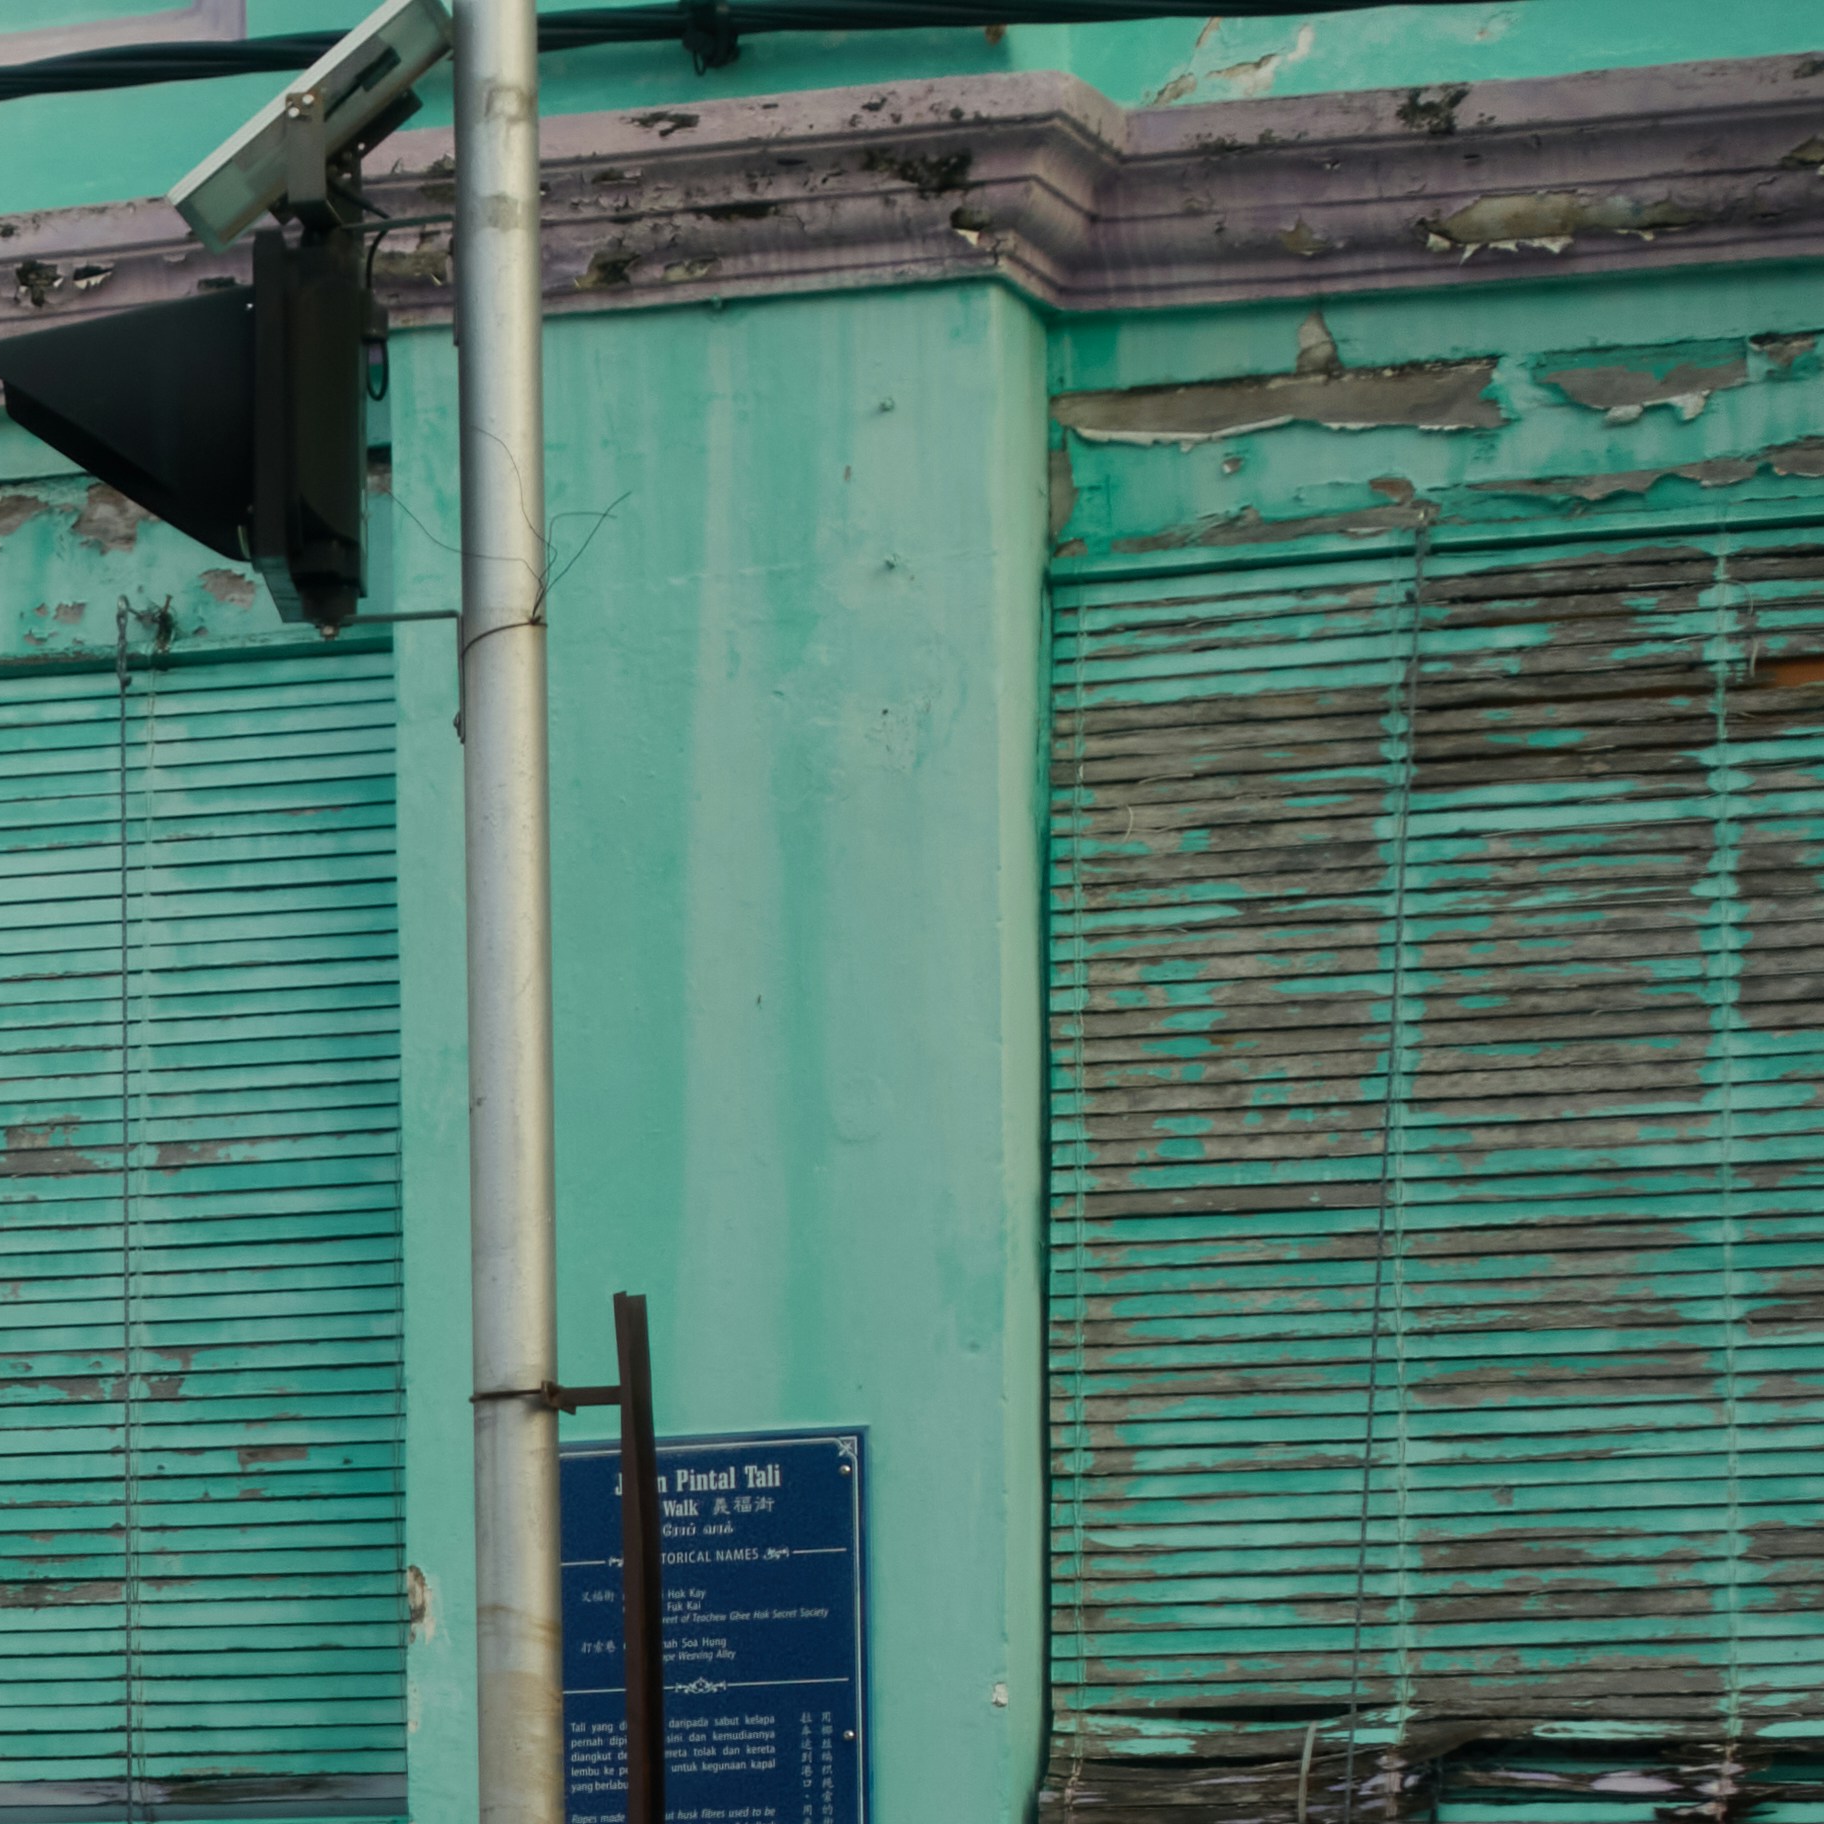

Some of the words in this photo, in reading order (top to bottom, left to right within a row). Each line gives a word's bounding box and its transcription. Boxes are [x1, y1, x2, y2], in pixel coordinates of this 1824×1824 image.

[676, 1466, 736, 1492] Pintal
[744, 1464, 781, 1489] Tali
[663, 1500, 699, 1518] Walk
[661, 1550, 711, 1565] TORICAL
[716, 1548, 759, 1561] NAMES
[667, 1601, 683, 1611] Fuk
[571, 1722, 586, 1732] Tali
[592, 1723, 613, 1733] yang
[669, 1717, 709, 1729] daripada
[715, 1716, 739, 1726] sabut
[745, 1715, 775, 1726] kelapa
[571, 1737, 603, 1748] pernah
[688, 1732, 707, 1742] dan
[713, 1730, 775, 1742] kemudiannya
[571, 1751, 612, 1764] diangkut
[693, 1747, 717, 1757] tolak
[723, 1746, 740, 1756] dan
[746, 1745, 776, 1755] kereta
[571, 1766, 600, 1777] lembu
[604, 1766, 615, 1776] ke
[671, 1763, 698, 1773] untuk
[702, 1761, 746, 1774] kegunaan
[751, 1759, 776, 1771] kapal
[571, 1783, 593, 1794] yang
[600, 1813, 625, 1823] made
[729, 1807, 749, 1818] used
[752, 1807, 761, 1817] to
[764, 1807, 776, 1817] be
